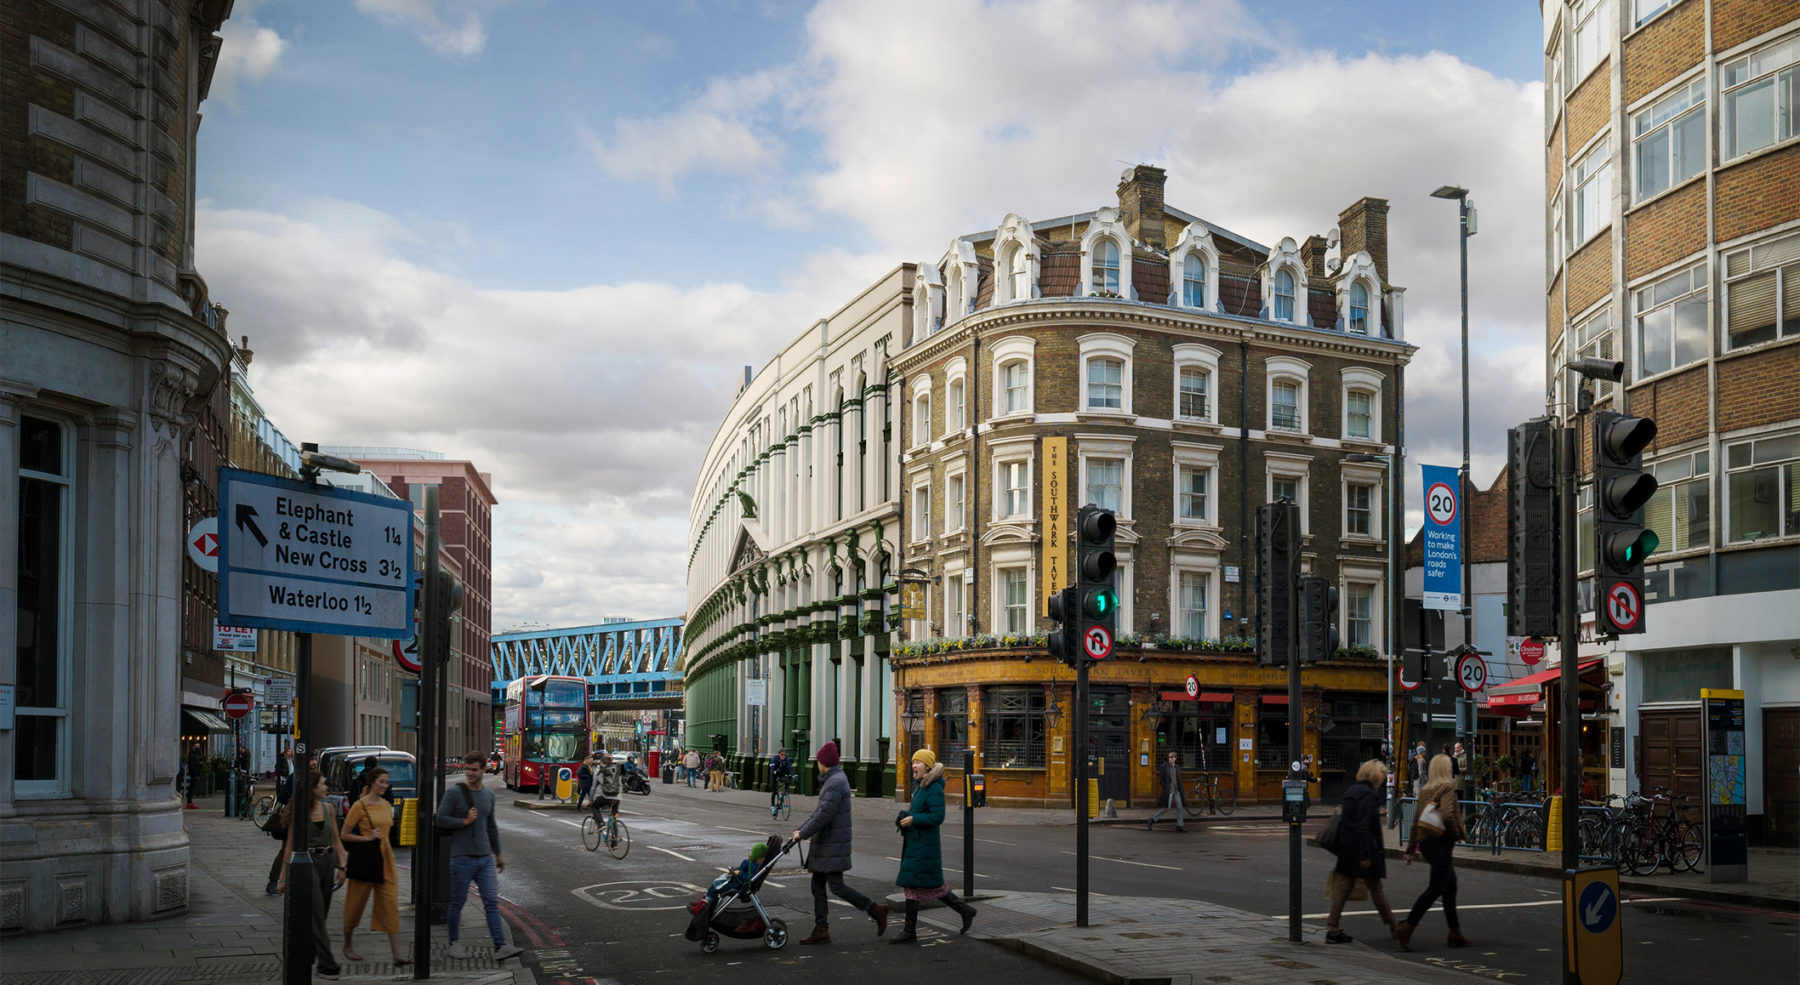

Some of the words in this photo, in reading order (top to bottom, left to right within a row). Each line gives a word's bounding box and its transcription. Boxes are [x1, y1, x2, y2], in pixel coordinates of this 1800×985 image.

[276, 497, 354, 527] Elephant
[1050, 471, 1059, 548] SOUTHWARK
[1432, 494, 1453, 513] 20
[279, 522, 291, 540] &
[295, 523, 352, 549] Castle
[1428, 530, 1455, 542] Working
[1428, 541, 1436, 549] to
[1437, 542, 1454, 550] make
[276, 544, 315, 567] New
[319, 550, 368, 574] Cross
[1428, 550, 1457, 560] London's
[1428, 560, 1446, 568] roads
[1050, 556, 1058, 597] TAVER
[1428, 569, 1445, 577] safer
[268, 585, 349, 611] Waterloo
[1036, 665, 1106, 676] SOUTHRK
[1463, 665, 1483, 682] 20
[1187, 681, 1197, 693] 20
[297, 744, 304, 753] S
[596, 886, 698, 904] 20
